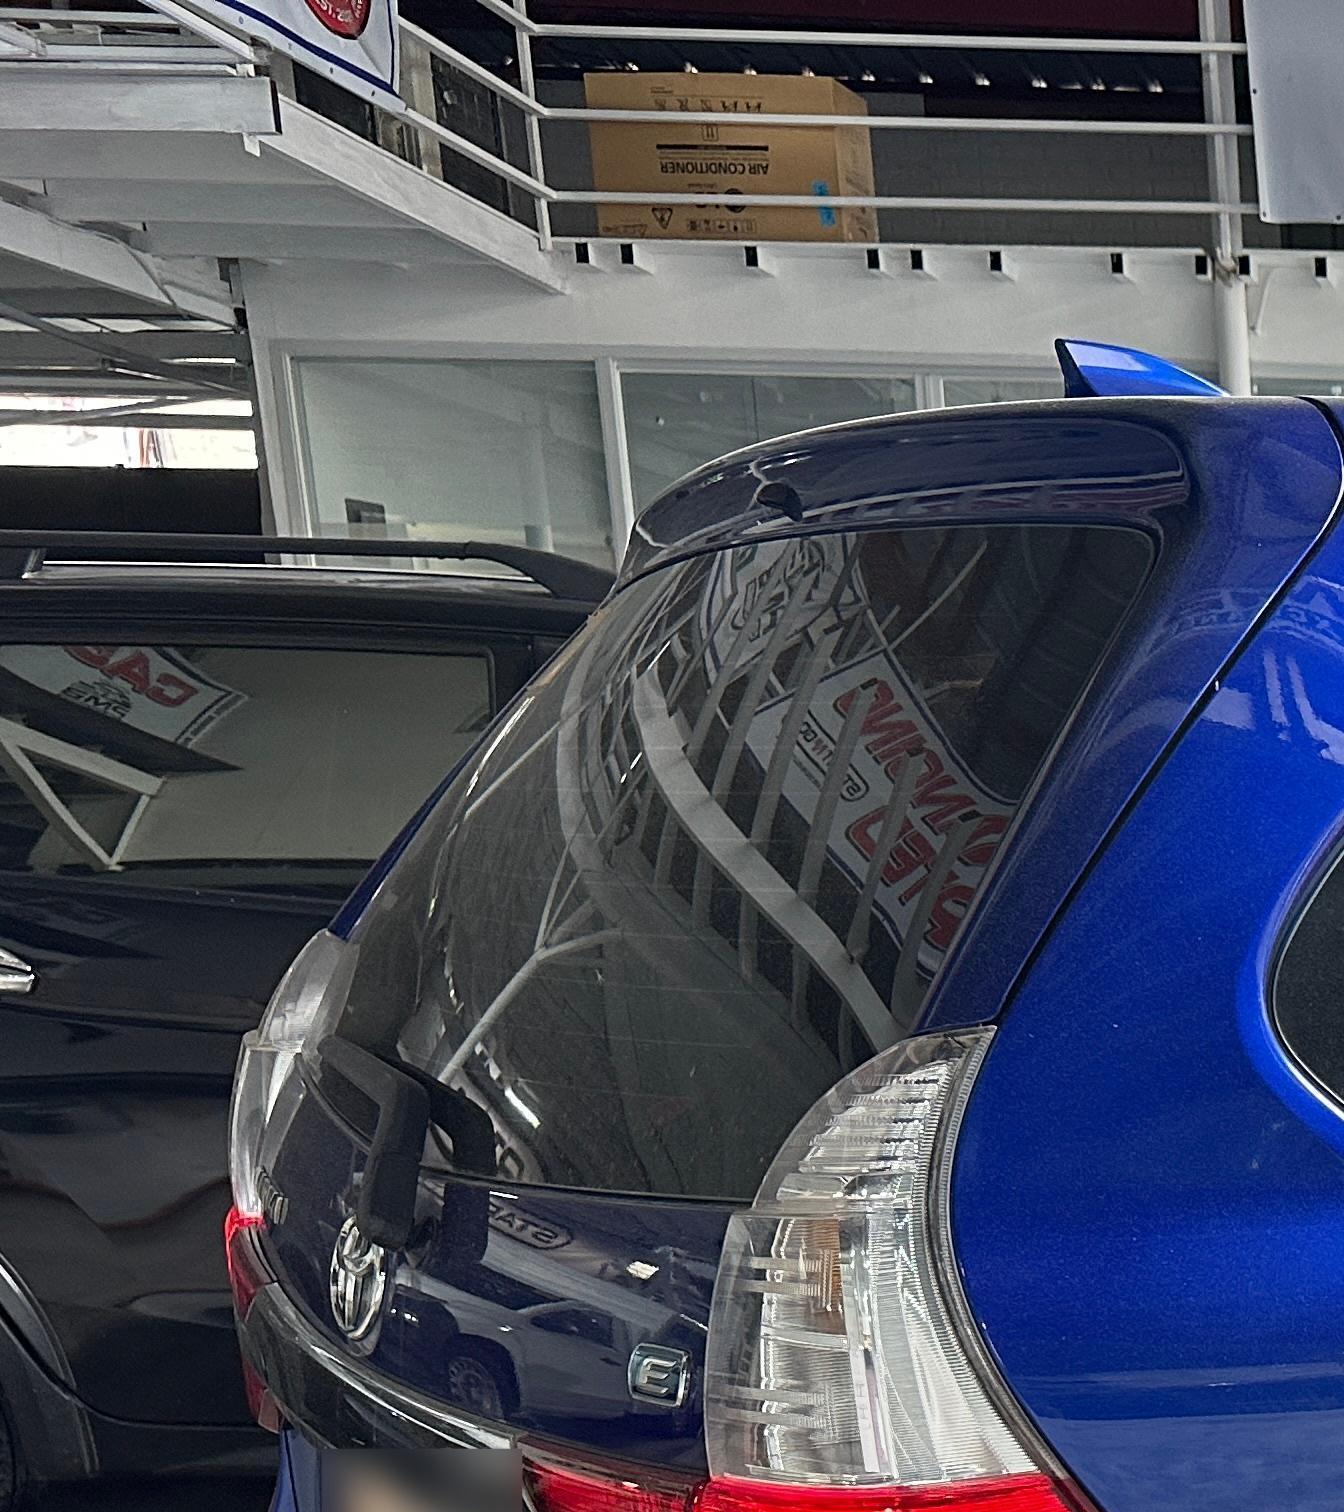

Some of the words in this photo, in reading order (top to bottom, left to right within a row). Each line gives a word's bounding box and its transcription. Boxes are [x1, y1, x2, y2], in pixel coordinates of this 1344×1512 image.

[660, 161, 746, 174] CONDITIONER
[748, 163, 769, 175] AIR
[639, 1356, 678, 1397] E
